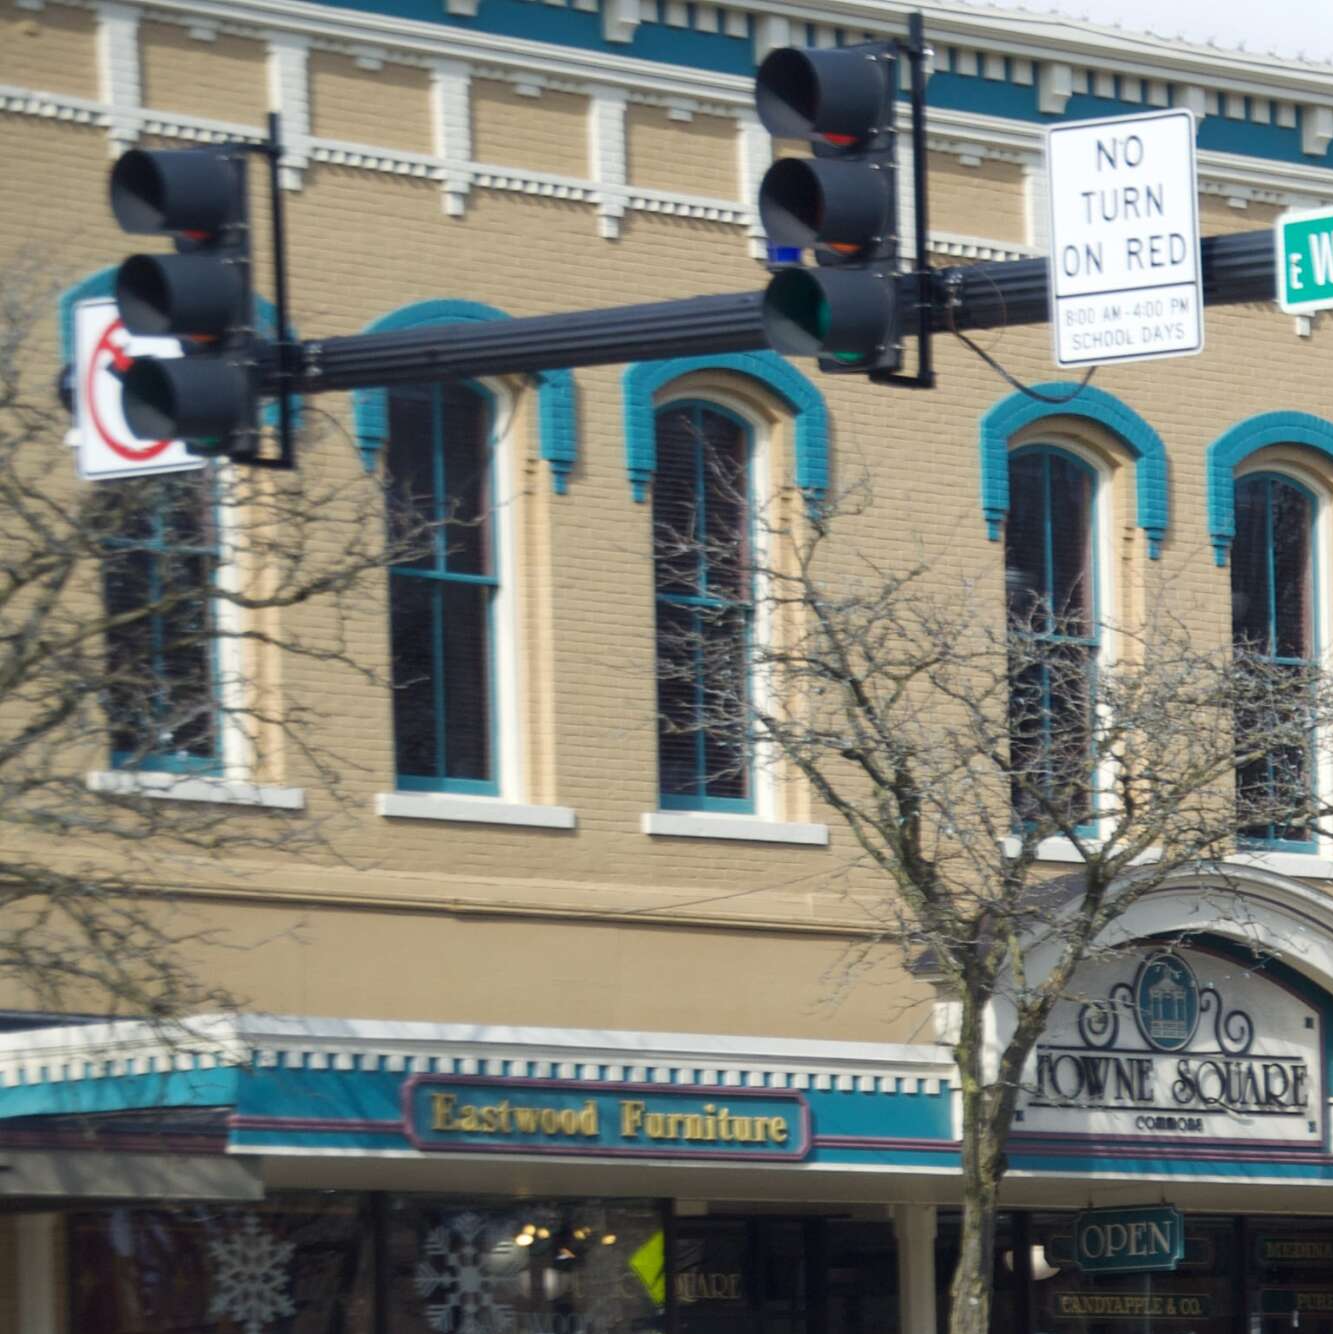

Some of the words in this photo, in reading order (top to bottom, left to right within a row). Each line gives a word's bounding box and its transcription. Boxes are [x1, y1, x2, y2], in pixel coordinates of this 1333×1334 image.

[1095, 135, 1144, 172] NO
[1081, 183, 1164, 224] TURN
[1063, 243, 1105, 277] ON
[1126, 232, 1188, 271] RED
[1288, 253, 1304, 290] E
[1072, 328, 1136, 351] SCHOOL
[1142, 321, 1187, 344] DAYS
[1035, 1053, 1156, 1102] TOWNE
[1171, 1059, 1308, 1109] SQUARE
[431, 1092, 601, 1137] Eastwood
[620, 1100, 789, 1143] Furniture
[1081, 1220, 1174, 1258] OPEN
